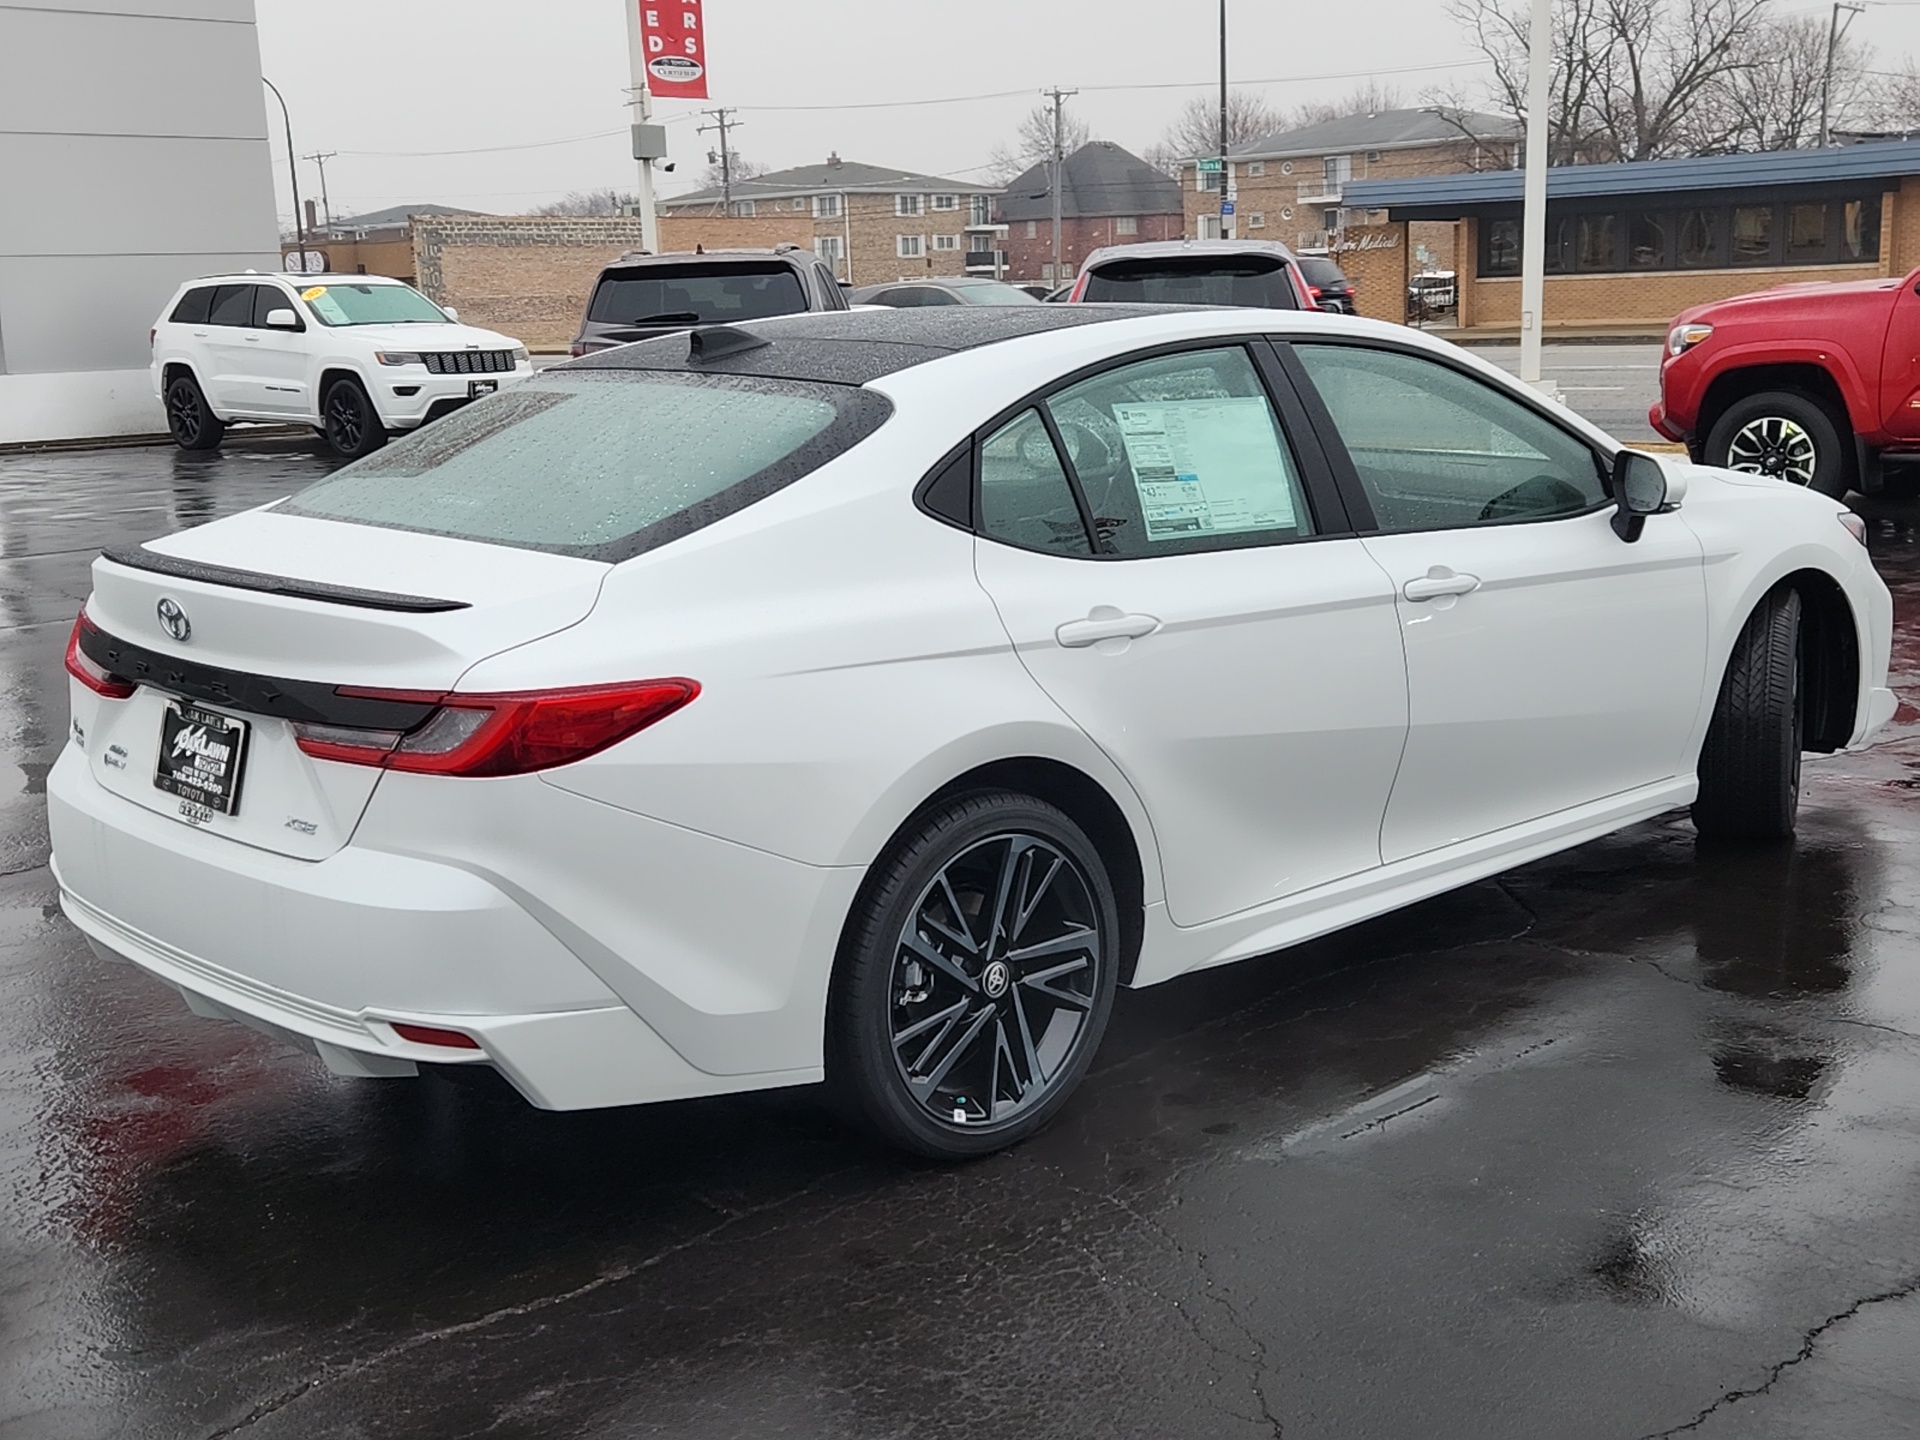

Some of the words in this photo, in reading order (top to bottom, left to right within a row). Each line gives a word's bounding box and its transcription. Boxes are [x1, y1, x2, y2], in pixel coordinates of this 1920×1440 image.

[646, 0, 664, 52] ED
[682, 0, 697, 54] RS
[1357, 233, 1400, 251] Medical
[198, 757, 223, 774] TOYOTA
[177, 783, 206, 804] TOYOTA
